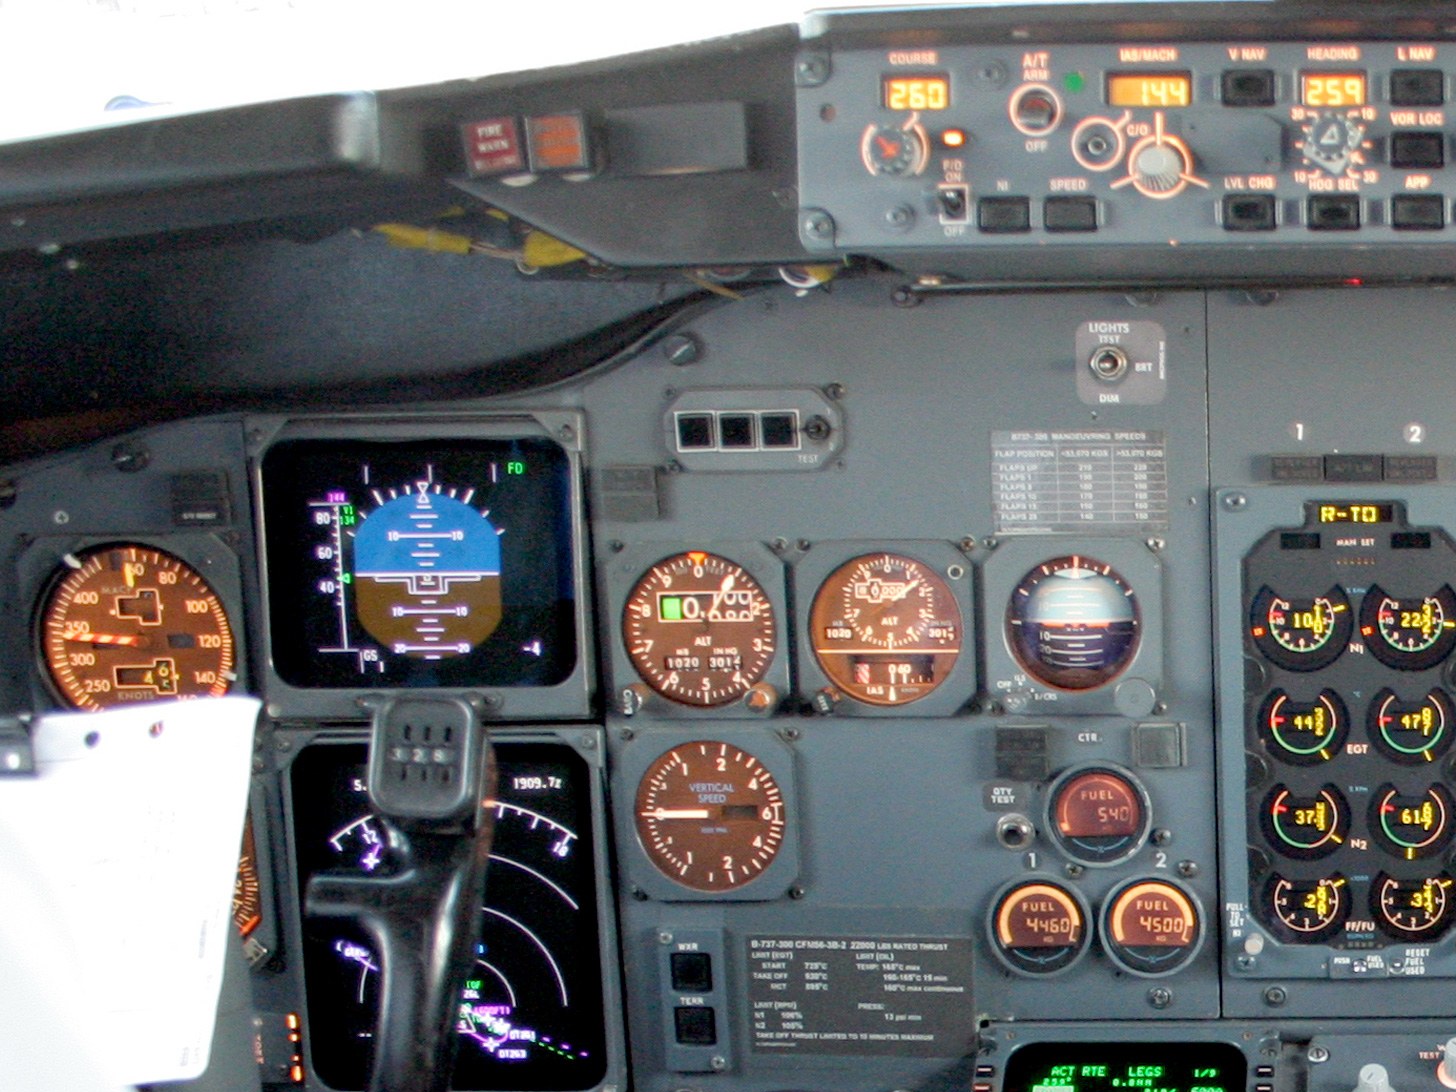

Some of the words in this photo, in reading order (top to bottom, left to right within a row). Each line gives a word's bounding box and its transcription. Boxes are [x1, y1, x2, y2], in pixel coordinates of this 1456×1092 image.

[889, 52, 938, 65] COURSE
[1120, 49, 1176, 62] IAS/MACH
[1229, 49, 1240, 61] V
[1242, 49, 1267, 61] NAV
[1307, 49, 1361, 61] HEADING
[1398, 49, 1407, 61] L
[1409, 49, 1434, 61] NAV
[1023, 54, 1048, 69] A/T
[1023, 69, 1048, 82] ARM
[889, 82, 947, 110] 260
[1141, 80, 1189, 106] 144
[1306, 80, 1362, 106] 259
[1390, 112, 1416, 125] VOR
[1419, 112, 1443, 125] LOC
[1025, 140, 1048, 152] OFF
[1050, 179, 1087, 191] SPEED
[1224, 177, 1243, 189] LVL
[1249, 177, 1275, 189] CHG
[1405, 176, 1429, 189] APP
[1088, 322, 1130, 334] LIGHTS
[507, 461, 524, 475] FD
[316, 512, 330, 524] 80
[1321, 506, 1377, 523] R-TO
[694, 636, 712, 647] ALT
[1078, 733, 1097, 742] CTR
[1347, 744, 1368, 754] EGT
[689, 783, 734, 793] VERTICAL
[698, 794, 727, 803] SPEED
[1081, 790, 1114, 800] FUEL
[1098, 806, 1129, 823] 540
[1022, 902, 1055, 912] FUEL
[1136, 901, 1169, 911] FUEL
[1026, 918, 1070, 934] 4460
[1140, 916, 1184, 933] 4500
[1419, 1051, 1440, 1060] TEST
[1051, 1066, 1076, 1077] ACT
[1082, 1066, 1106, 1077] RTE
[1128, 1066, 1163, 1077] LEGS
